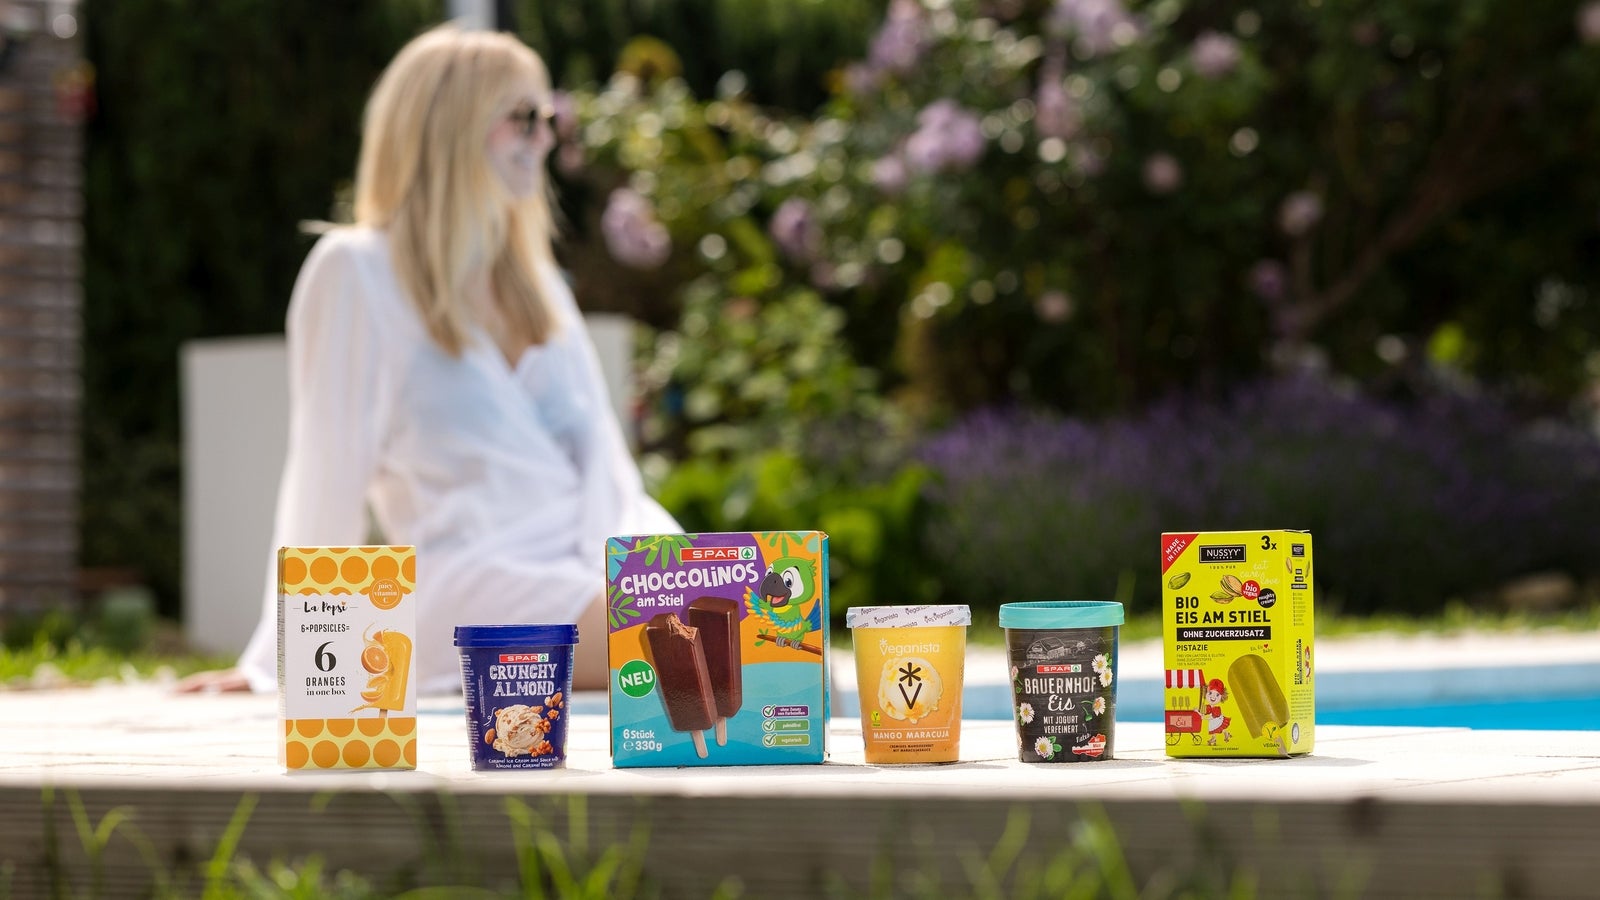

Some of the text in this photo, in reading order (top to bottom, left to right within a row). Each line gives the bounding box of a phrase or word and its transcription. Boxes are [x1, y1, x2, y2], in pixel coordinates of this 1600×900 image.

[1166, 538, 1180, 554] MADE
[1261, 535, 1277, 550] 3x
[692, 550, 737, 558] SPAR
[1167, 540, 1187, 562] IN ITALY
[378, 583, 393, 592] juicy
[1245, 583, 1258, 592] bio
[636, 594, 684, 607] am Stiel
[1176, 597, 1199, 609] BIO
[304, 601, 347, 616] La Popsi
[874, 613, 899, 624] Veganista
[1176, 610, 1271, 624] EIS AM STIEL
[1205, 629, 1264, 638] ZUCKERZUSATZ
[880, 638, 940, 656] Veganista
[314, 641, 336, 672] 6
[489, 664, 558, 680] CRUNCHY
[306, 676, 346, 686] ORANGES
[621, 670, 653, 688] NEU
[1025, 677, 1096, 694] BAUERNHOF
[493, 681, 554, 696] ALMOND
[1048, 694, 1075, 711] Eis
[1043, 716, 1079, 724] MIT JOGURT
[623, 729, 655, 739] 6 Stück
[906, 730, 950, 739] MARACUJA
[1044, 725, 1078, 734] VERFEINERT
